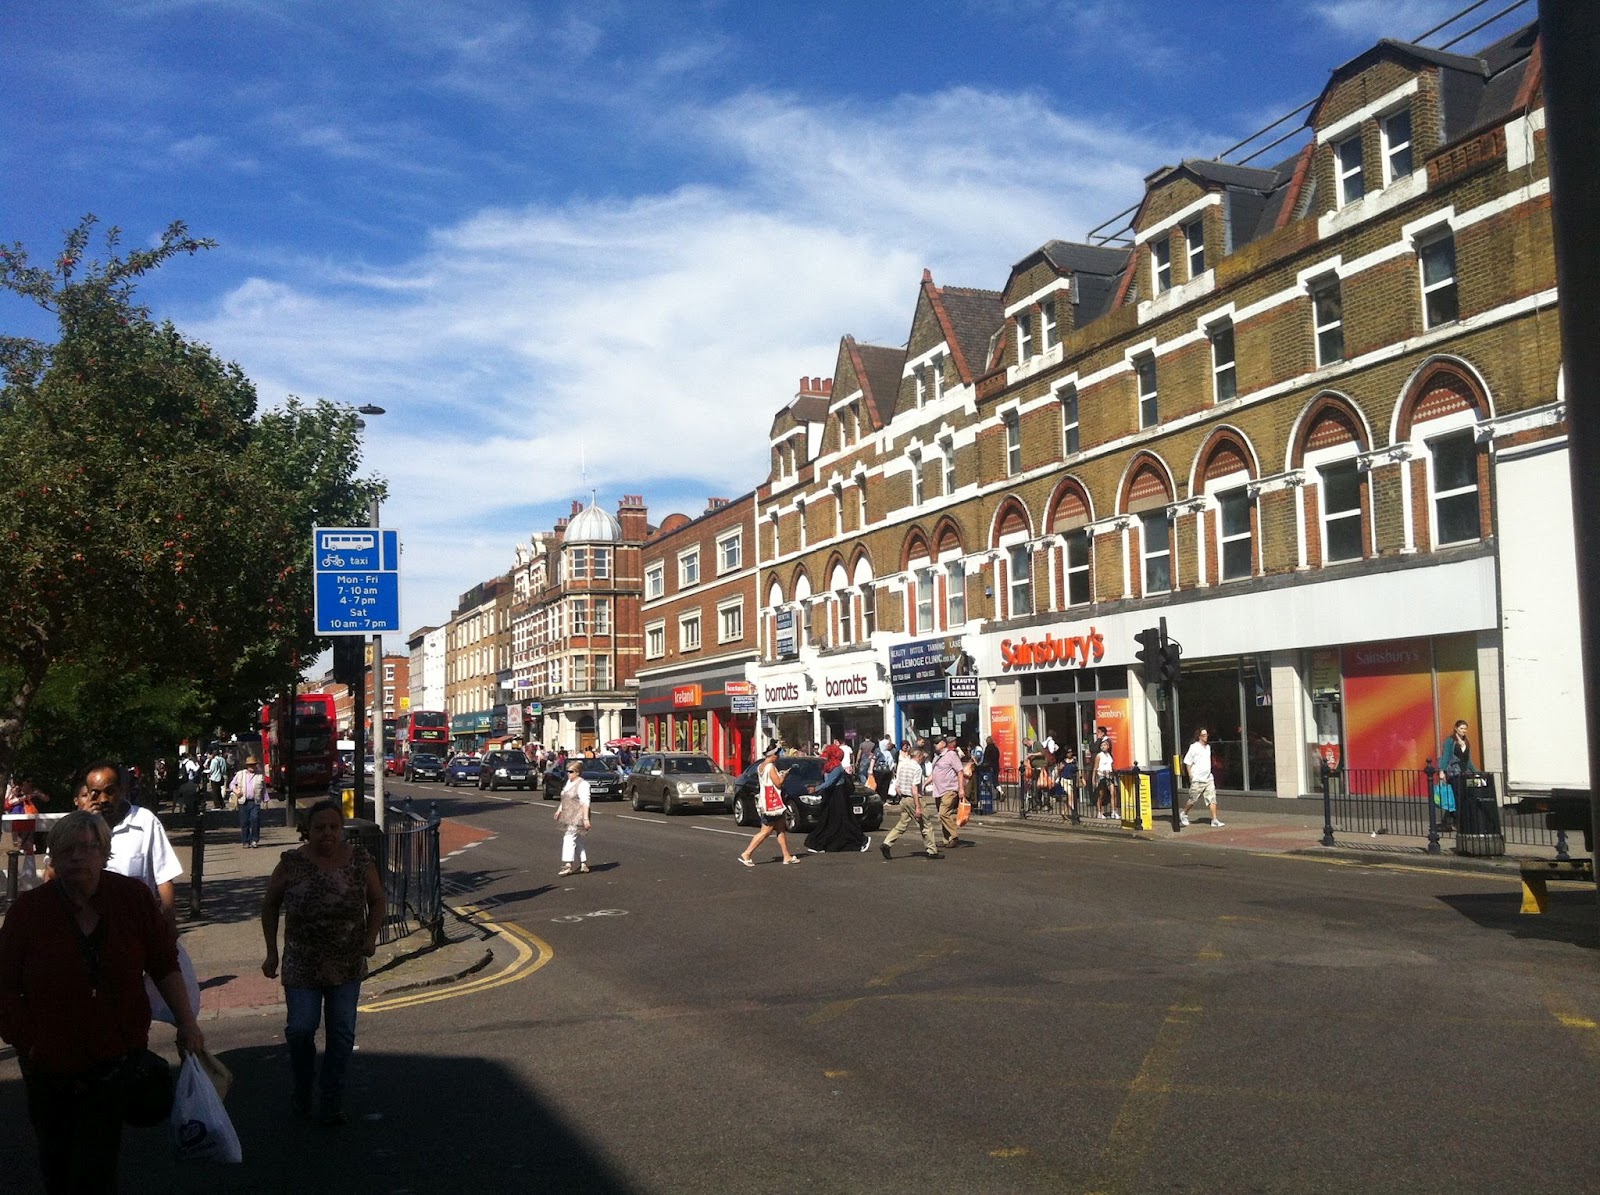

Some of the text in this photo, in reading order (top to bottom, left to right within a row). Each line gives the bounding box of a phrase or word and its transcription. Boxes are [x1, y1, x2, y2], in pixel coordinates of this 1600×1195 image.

[350, 556, 368, 565] taxi
[337, 576, 358, 584] Mon
[366, 576, 378, 584] Fri
[362, 598, 376, 606] pm
[350, 608, 367, 617] Sat
[330, 620, 341, 628] 10
[365, 620, 371, 628] 7
[372, 621, 387, 629] pm
[927, 642, 946, 652] TANNING
[1000, 626, 1105, 668] Sainsbury's
[1356, 649, 1419, 666] Sainsbury's
[826, 674, 868, 698] barratts
[765, 682, 798, 702] barratts
[674, 690, 694, 704] Iceland
[1097, 710, 1126, 719] Sainsbury's
